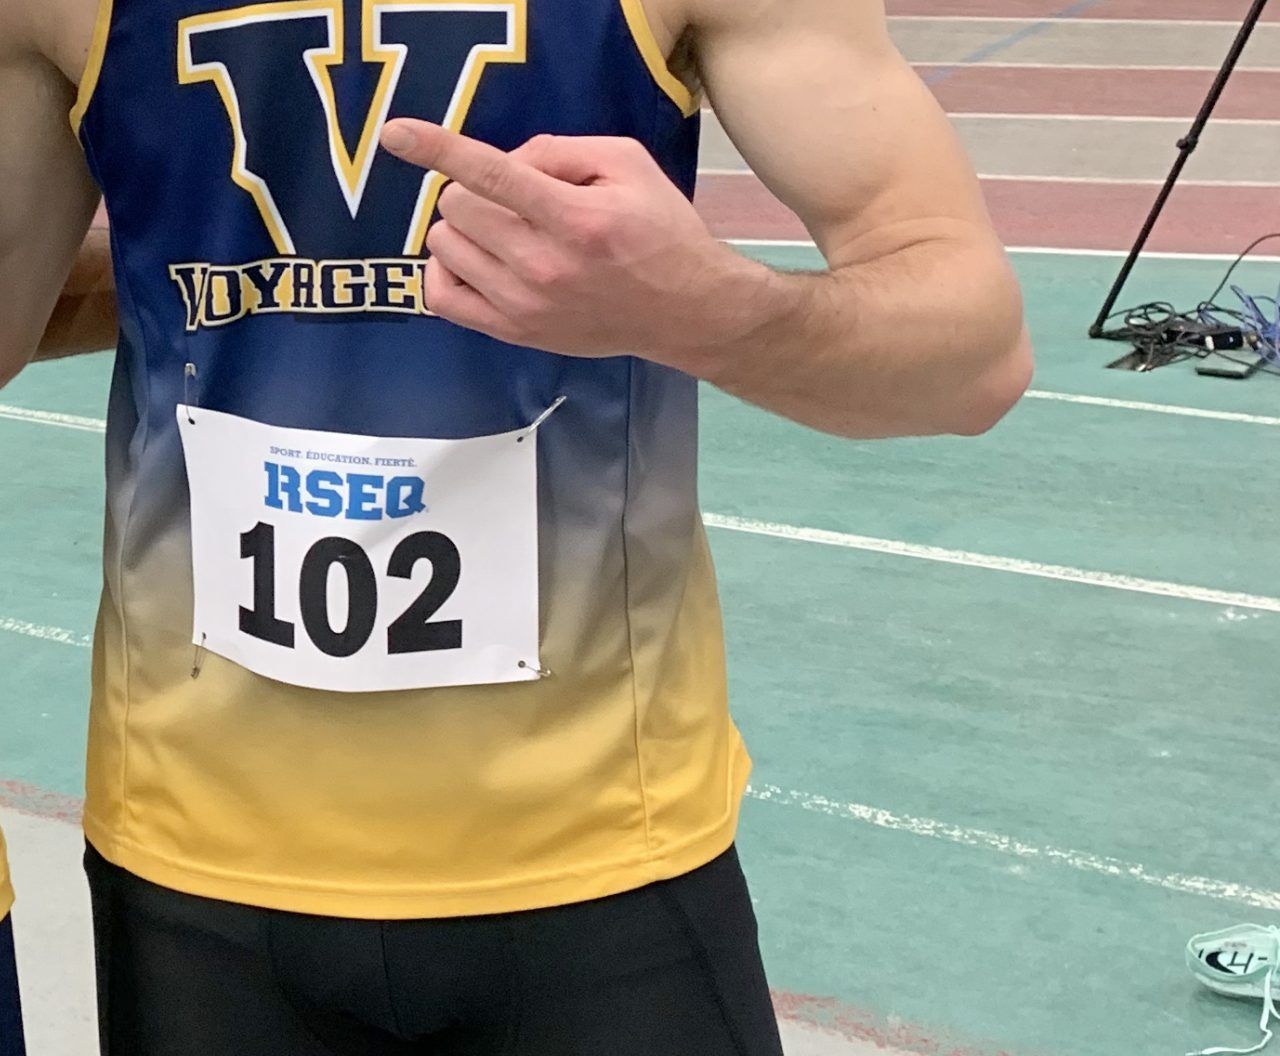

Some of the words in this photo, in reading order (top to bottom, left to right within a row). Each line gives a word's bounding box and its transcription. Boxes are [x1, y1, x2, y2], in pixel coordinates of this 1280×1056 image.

[168, 258, 435, 332] VOYAGE
[264, 462, 427, 521] RSEQ
[238, 521, 463, 658] 102
